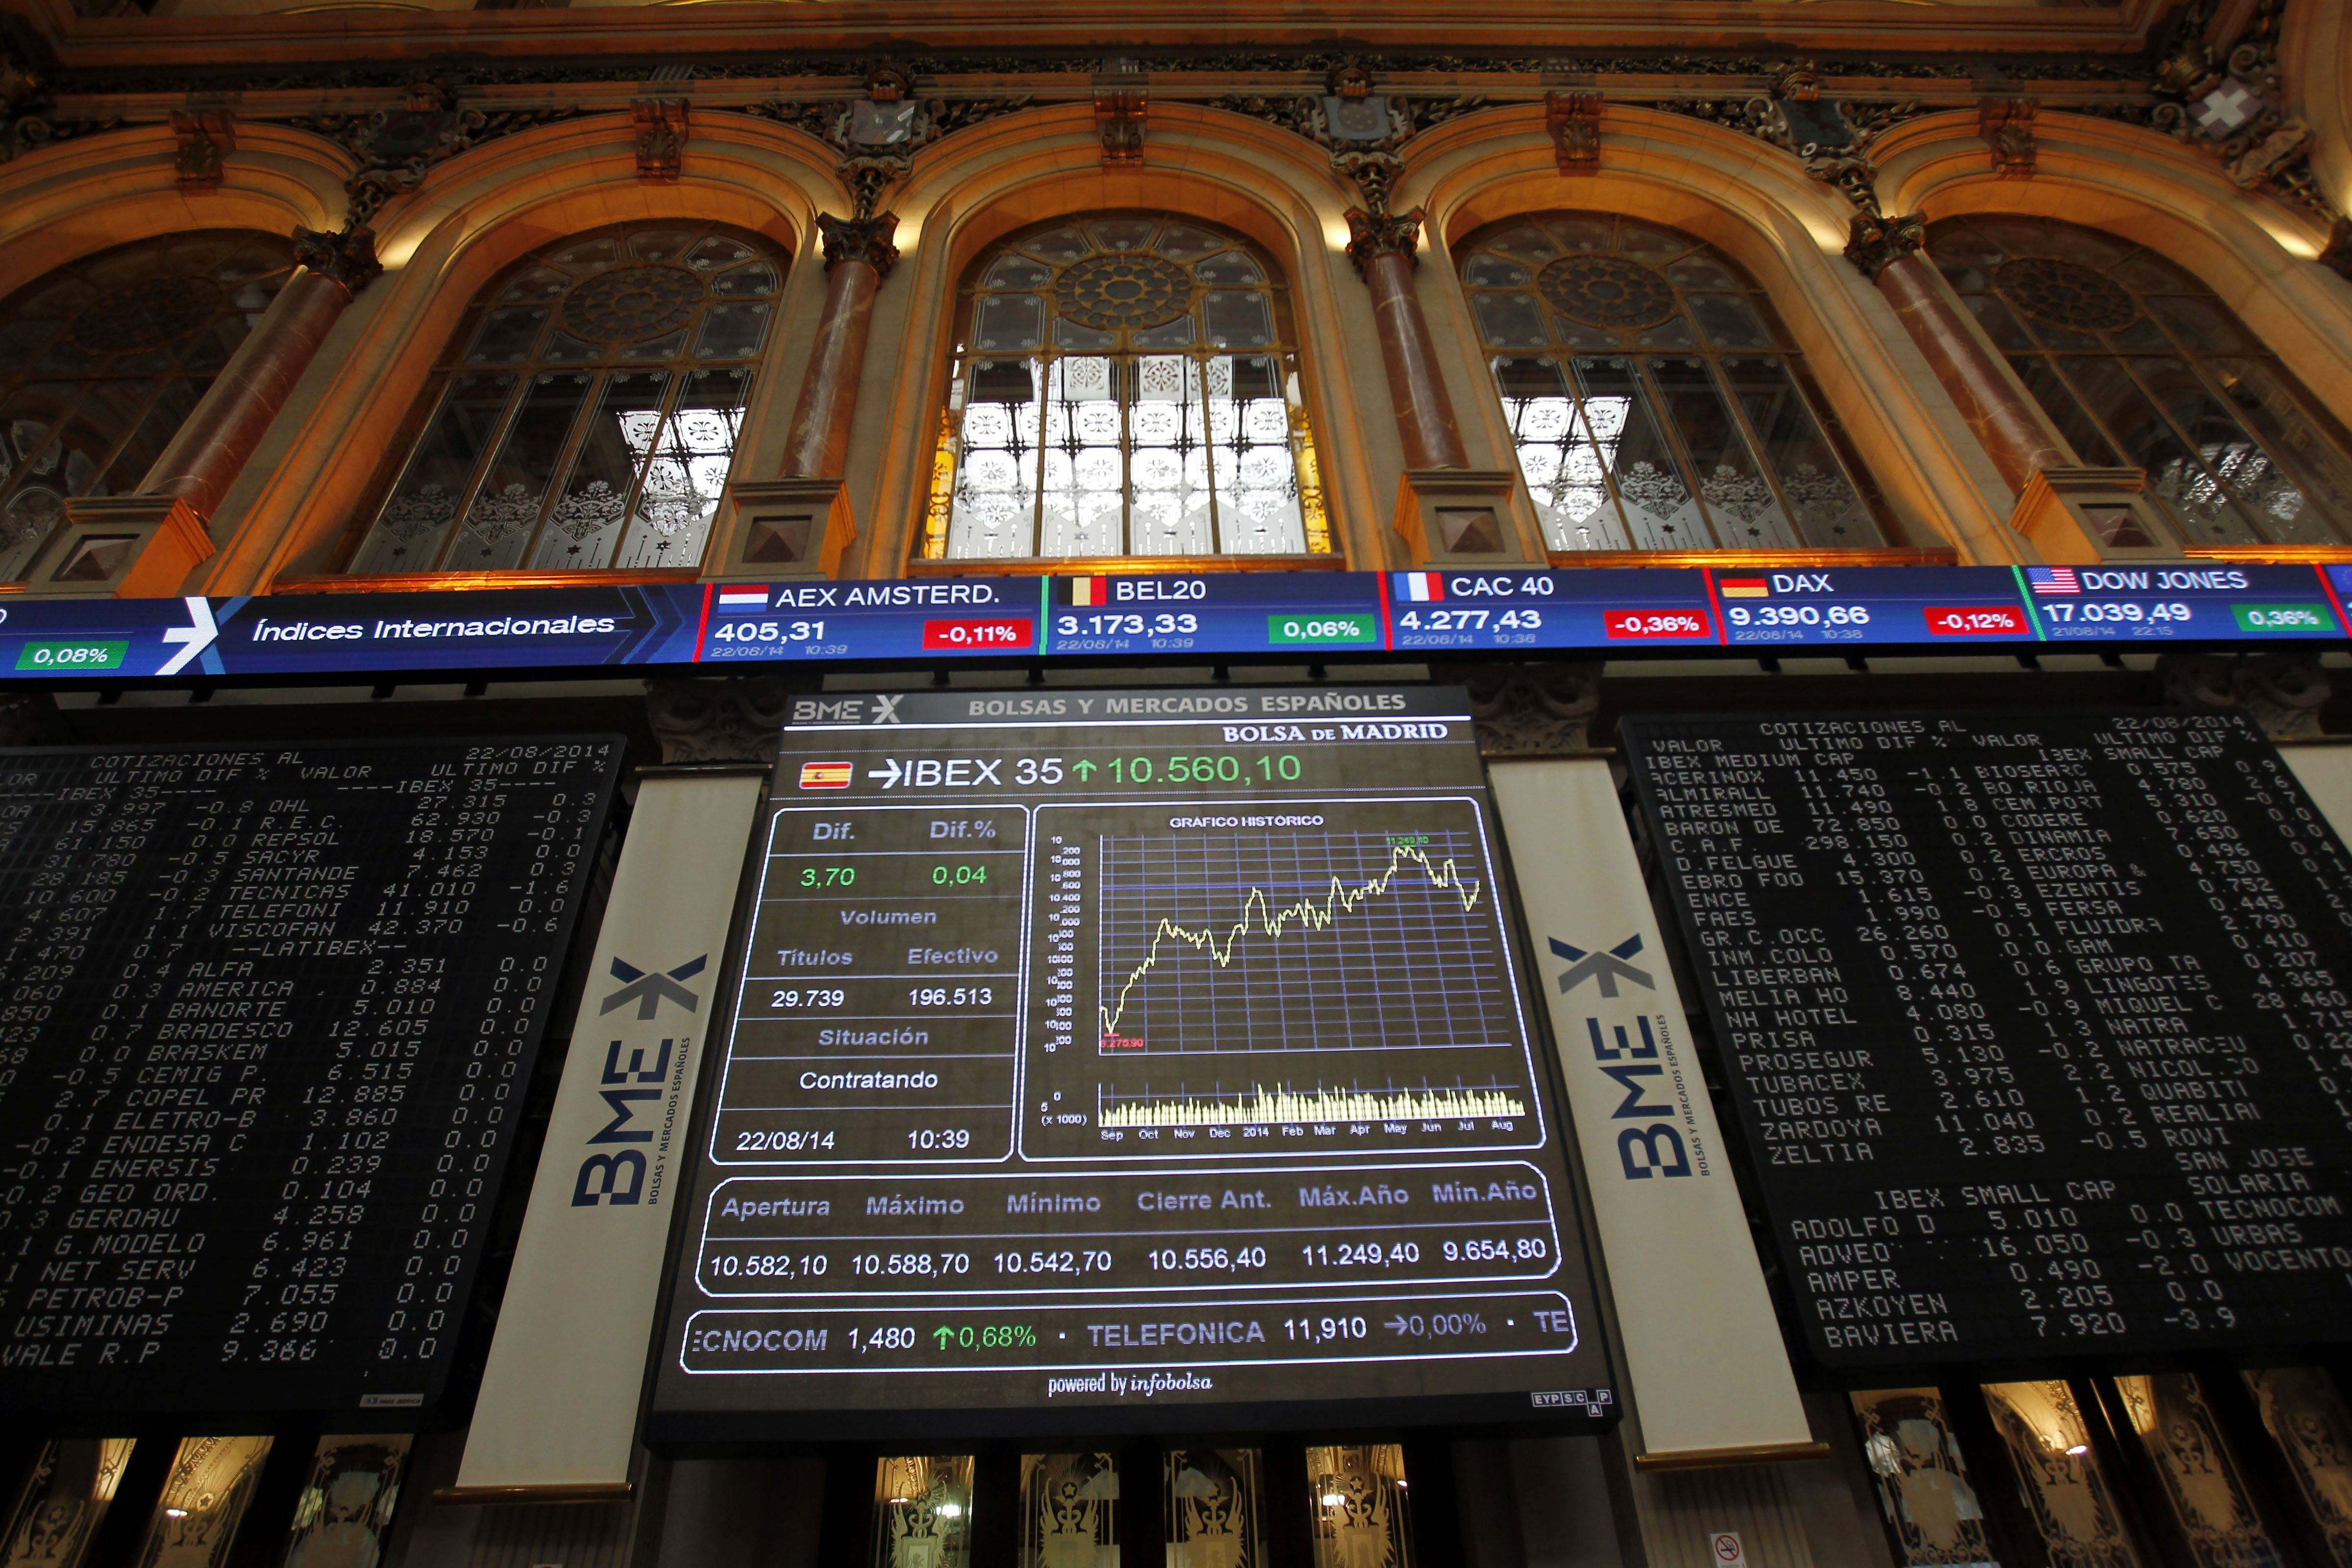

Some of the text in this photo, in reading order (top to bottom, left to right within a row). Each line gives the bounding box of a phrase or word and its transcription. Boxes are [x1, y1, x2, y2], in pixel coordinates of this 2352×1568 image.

[1117, 581, 1205, 600] BEL20
[1452, 577, 1554, 596] CAC 40
[1773, 574, 1834, 592] DAX
[2083, 572, 2248, 589] DOW JONES
[775, 585, 999, 607] AEX AMSTERD.
[1400, 610, 1699, 634] 4.277,43 -0,36%
[1730, 606, 2014, 630] 9.390,66 -0,12%
[2043, 604, 2320, 625] 17.039,49 0,36%
[253, 616, 614, 641] Índices Internacionales
[715, 621, 1016, 644] 405,31 -0,11%
[1058, 614, 1359, 639] 3.173,33 0,06%
[34, 648, 107, 666] 0,08%
[805, 644, 847, 654] 10:39
[793, 700, 863, 720] BME
[969, 692, 1406, 716] BOLSAS Y MERCADOS ESPAÑOLES
[1223, 726, 1306, 742] BOLSA
[1340, 724, 1447, 739] MADRID
[1760, 716, 2244, 735] COTIZACIONES 22/08/2014
[1653, 737, 1863, 752] VALOR ULTIMO
[91, 745, 609, 768] COTIZACIONES AL 22/08/2014
[1714, 753, 1854, 767] MEDIUM CAP
[431, 763, 517, 776] ULTIMO
[534, 761, 577, 773] DIF
[904, 755, 1301, 786] IBEX 35 10.560,10
[1660, 800, 1892, 818] ATRESMED 11.490
[252, 829, 494, 846] REPSOL 18.570
[813, 820, 996, 840] Dif. Dif.%
[243, 846, 488, 864] SACYR 4.153
[2018, 847, 2106, 861] ERCROS
[234, 864, 482, 882] SANTANDE 7.462
[801, 866, 986, 889] 3,70 0,04
[230, 885, 351, 900] TECNICAS
[1688, 887, 1932, 907] ENCE 1.615
[221, 900, 469, 918] TELEFONI 11.910
[841, 910, 936, 925] Volumen
[1693, 906, 1940, 926] FAES 1.990
[778, 948, 998, 965] Títulos Efectivo
[1713, 967, 1841, 986] LIBERBAN
[178, 981, 294, 997] AMERICA
[771, 988, 992, 1007] 29.739 196.513
[157, 1022, 293, 1039] BRADESCO
[818, 1027, 928, 1045] Situación
[1657, 1014, 1678, 1066] ESPAÑOLES
[1732, 1031, 1815, 1049] PRISA
[147, 1044, 268, 1061] BRASKEM
[1739, 1051, 1873, 1071] PROSEGUR
[800, 1072, 938, 1089] Contratando
[1586, 1015, 1692, 1180] BME
[1675, 1069, 1695, 1124] MERCADOS
[571, 1039, 673, 1207] BME
[648, 1162, 664, 1206] BOLSAS
[660, 1094, 678, 1152] MERCADOS
[672, 1037, 690, 1092] ESPAÑOLES
[1101, 1120, 1513, 1141] Sep Oct Nov Dec 2014 Feb Mar Apr May Jun Jul Aug
[1761, 1118, 1882, 1140] ZARDOYA
[102, 1134, 211, 1153] ENDESA
[737, 1130, 969, 1150] 22/08/14 10:39
[1768, 1135, 2045, 1164] ZELTIA 2.835
[1694, 1137, 1710, 1176] BOLSAS
[91, 1158, 220, 1178] ENERSIS
[2188, 1172, 2310, 1195] SOLARIA
[722, 1181, 1536, 1221] Apertura Máximo Mínimo Cierre Ant. Máx.Año Mín.Año
[1875, 1181, 2115, 1209] IBEX SMALL CAP
[2199, 1196, 2341, 1219] TECNOCOM
[67, 1208, 179, 1228] GERDAU
[55, 1234, 205, 1254] G.MODELO
[712, 1239, 1546, 1280] 10.582,10 10.588,70 10.542,70 10.556,40 11.249,40 9.654,80
[41, 1260, 196, 1281] NET SERV
[1808, 1269, 1900, 1292] AMPER
[27, 1286, 183, 1309] PETROB-P
[1816, 1294, 1947, 1319] AZKOYEN
[15, 1314, 173, 1337] USIMINAS
[849, 1328, 915, 1353] 1,480
[960, 1326, 1035, 1351] 0,68%
[1087, 1322, 1265, 1346] TELEFONICA
[1285, 1317, 1366, 1343] 11,910
[1410, 1313, 1486, 1339] 0,00%
[1534, 1311, 1569, 1332] TE
[1824, 1321, 1958, 1347] BAVIERA
[1048, 1372, 1212, 1397] powered by infobolsa
